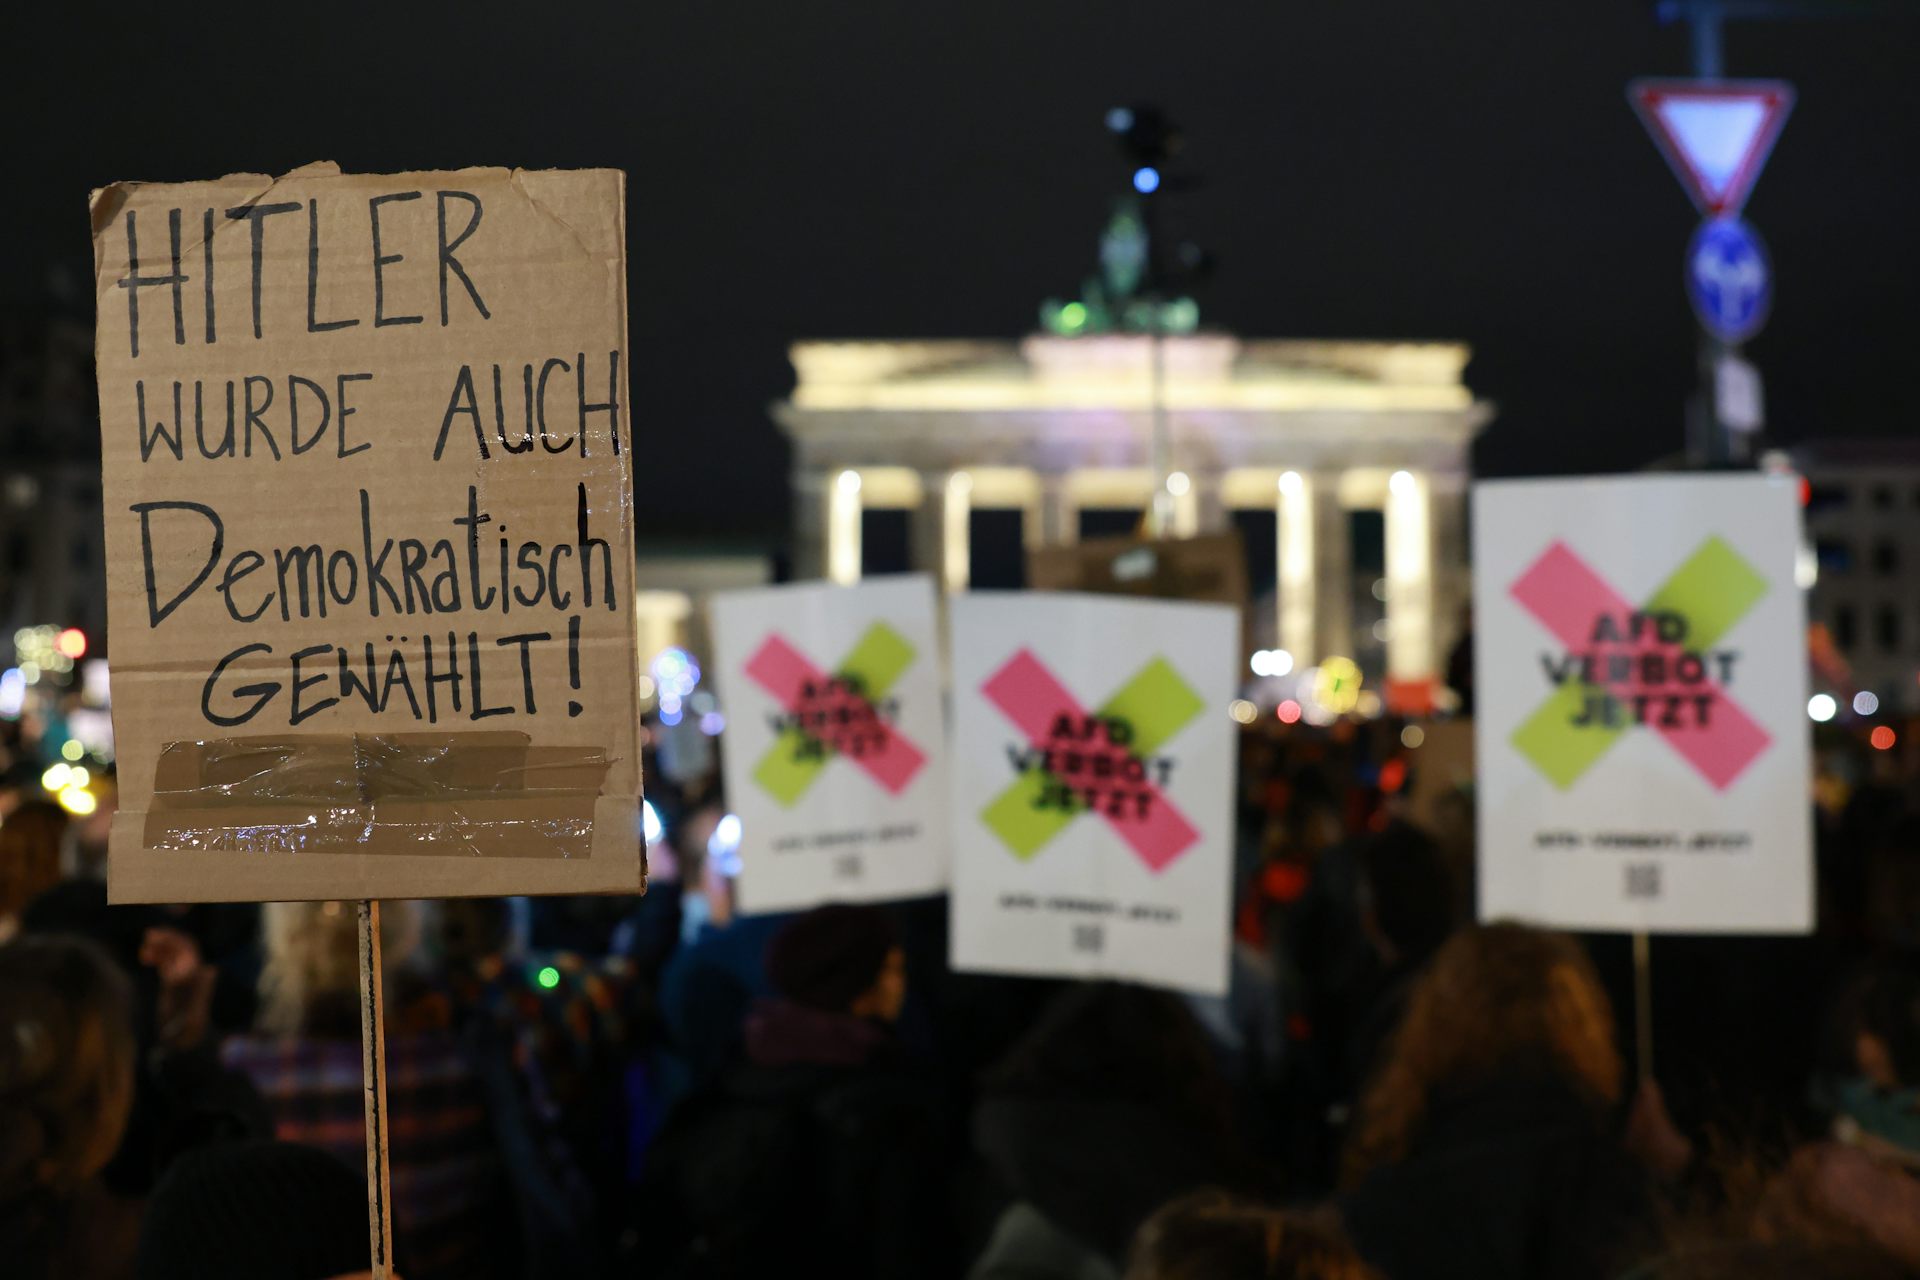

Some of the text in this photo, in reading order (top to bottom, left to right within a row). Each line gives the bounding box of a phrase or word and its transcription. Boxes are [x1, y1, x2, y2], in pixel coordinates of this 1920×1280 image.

[117, 190, 491, 358] HITLER
[135, 350, 620, 463] WURDE AUCH
[1592, 610, 1690, 645] AFD
[200, 615, 584, 727] GEWÄHLT!
[1540, 650, 1741, 686] VERBOT
[1570, 695, 1713, 729] JETZT
[1006, 741, 1176, 786] VERBOT
